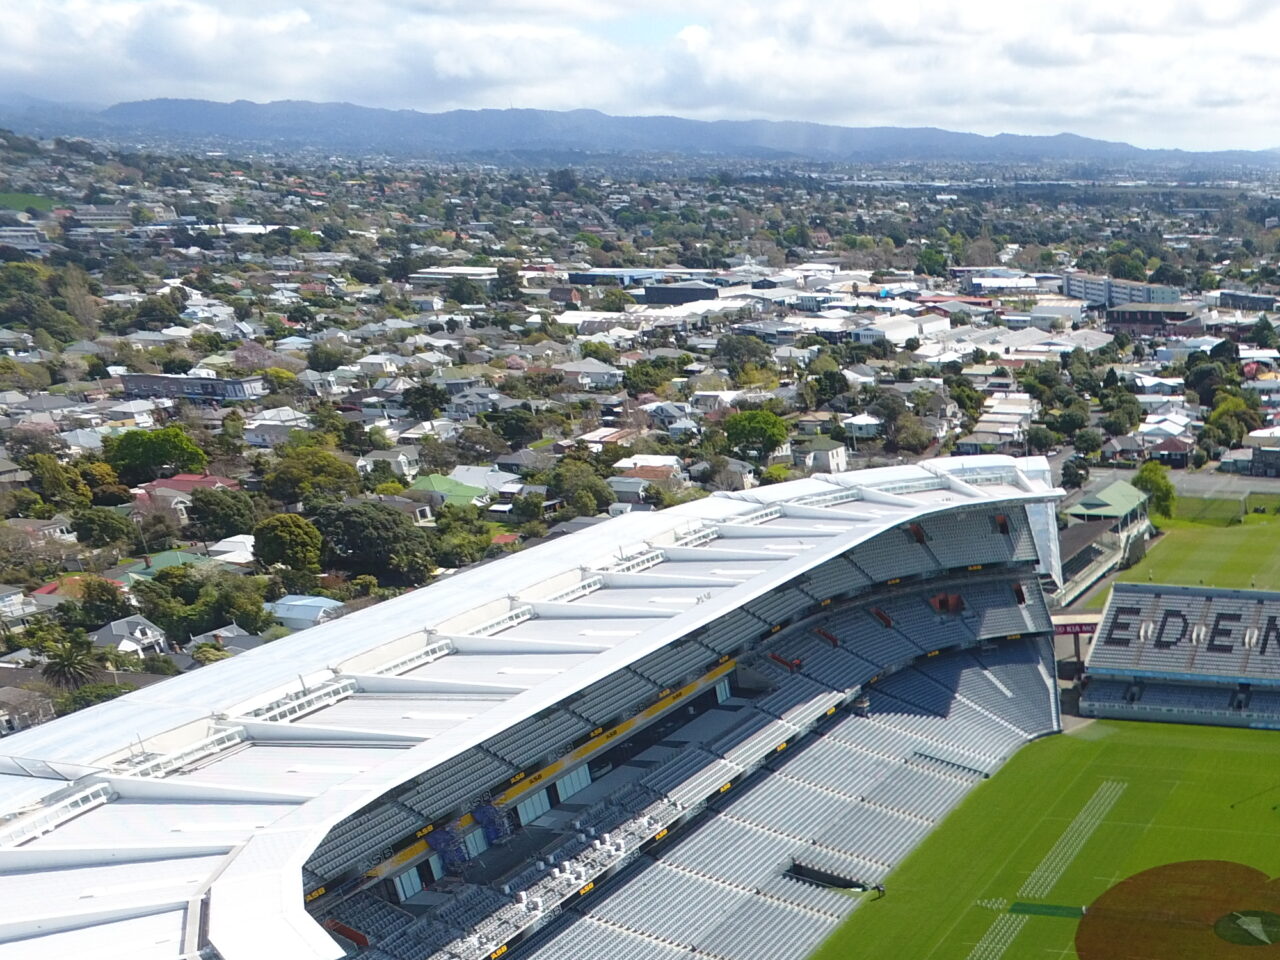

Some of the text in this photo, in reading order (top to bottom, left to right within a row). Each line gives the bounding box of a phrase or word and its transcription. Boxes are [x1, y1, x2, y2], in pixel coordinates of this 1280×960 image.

[1066, 624, 1080, 633] KIA
[659, 688, 671, 698] ASB
[589, 727, 603, 738] ASB
[510, 772, 526, 784] ASB
[530, 774, 543, 784] ASB
[416, 824, 434, 838] ASB
[655, 829, 668, 840] ASB
[579, 882, 594, 895] ASB
[306, 887, 326, 902] ASB
[490, 945, 508, 960] ASB
